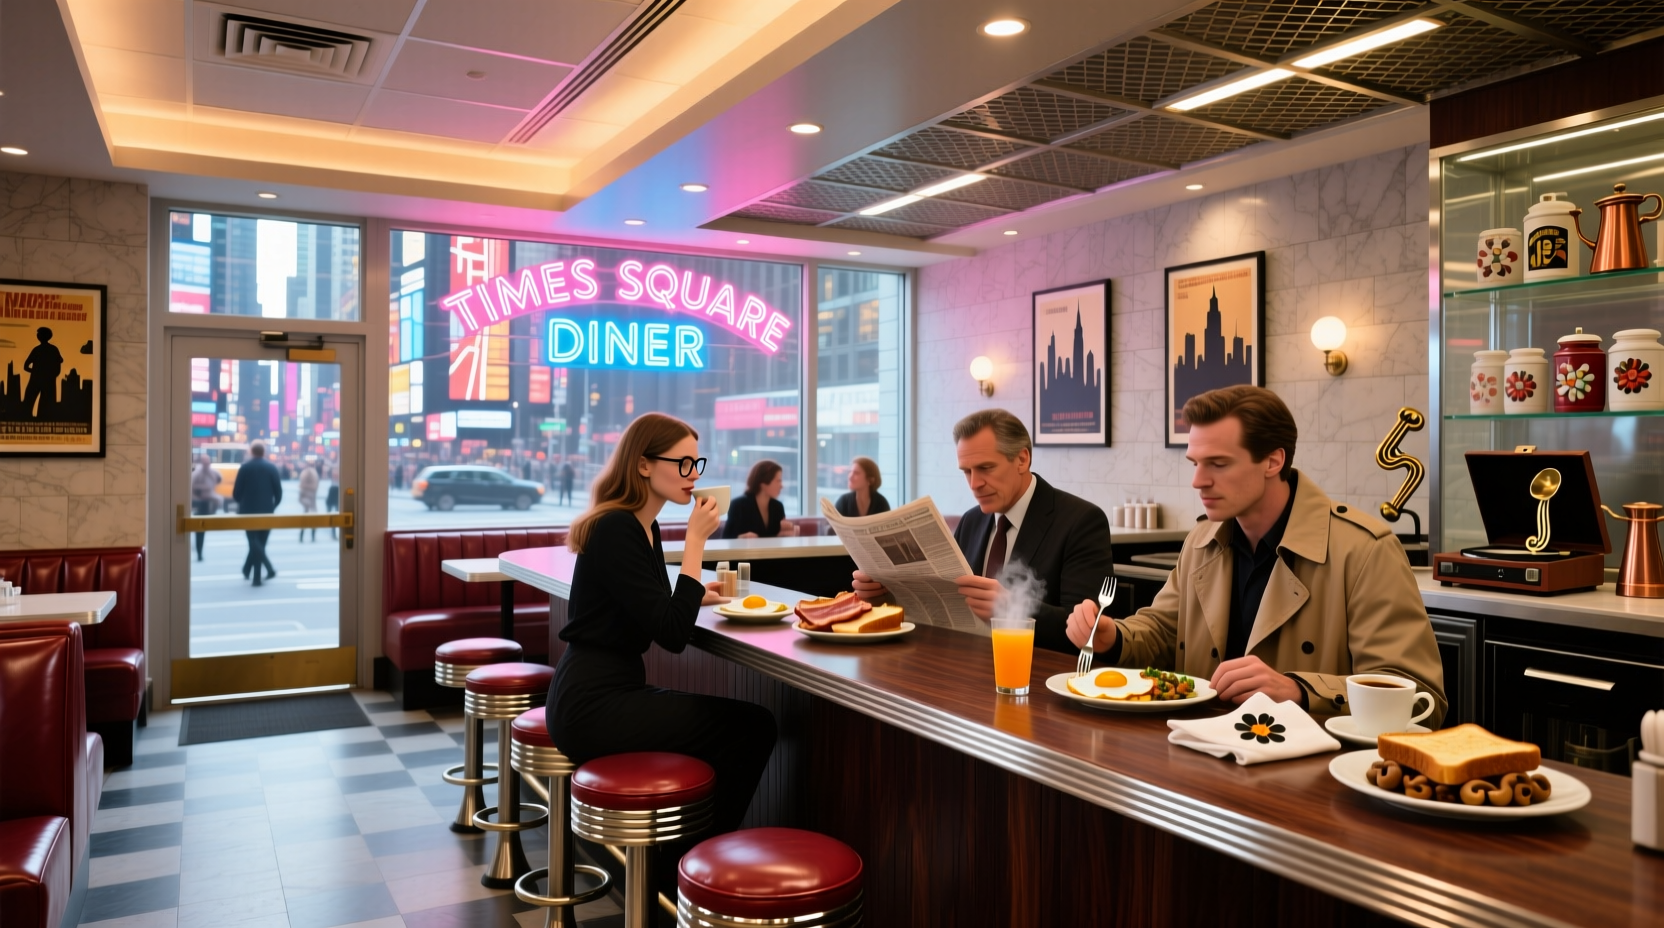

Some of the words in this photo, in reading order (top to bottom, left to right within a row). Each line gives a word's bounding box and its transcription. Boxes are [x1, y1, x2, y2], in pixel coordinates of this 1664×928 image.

[443, 259, 598, 331] TIMES
[618, 260, 791, 352] SQUARE
[548, 318, 704, 368] DINER
